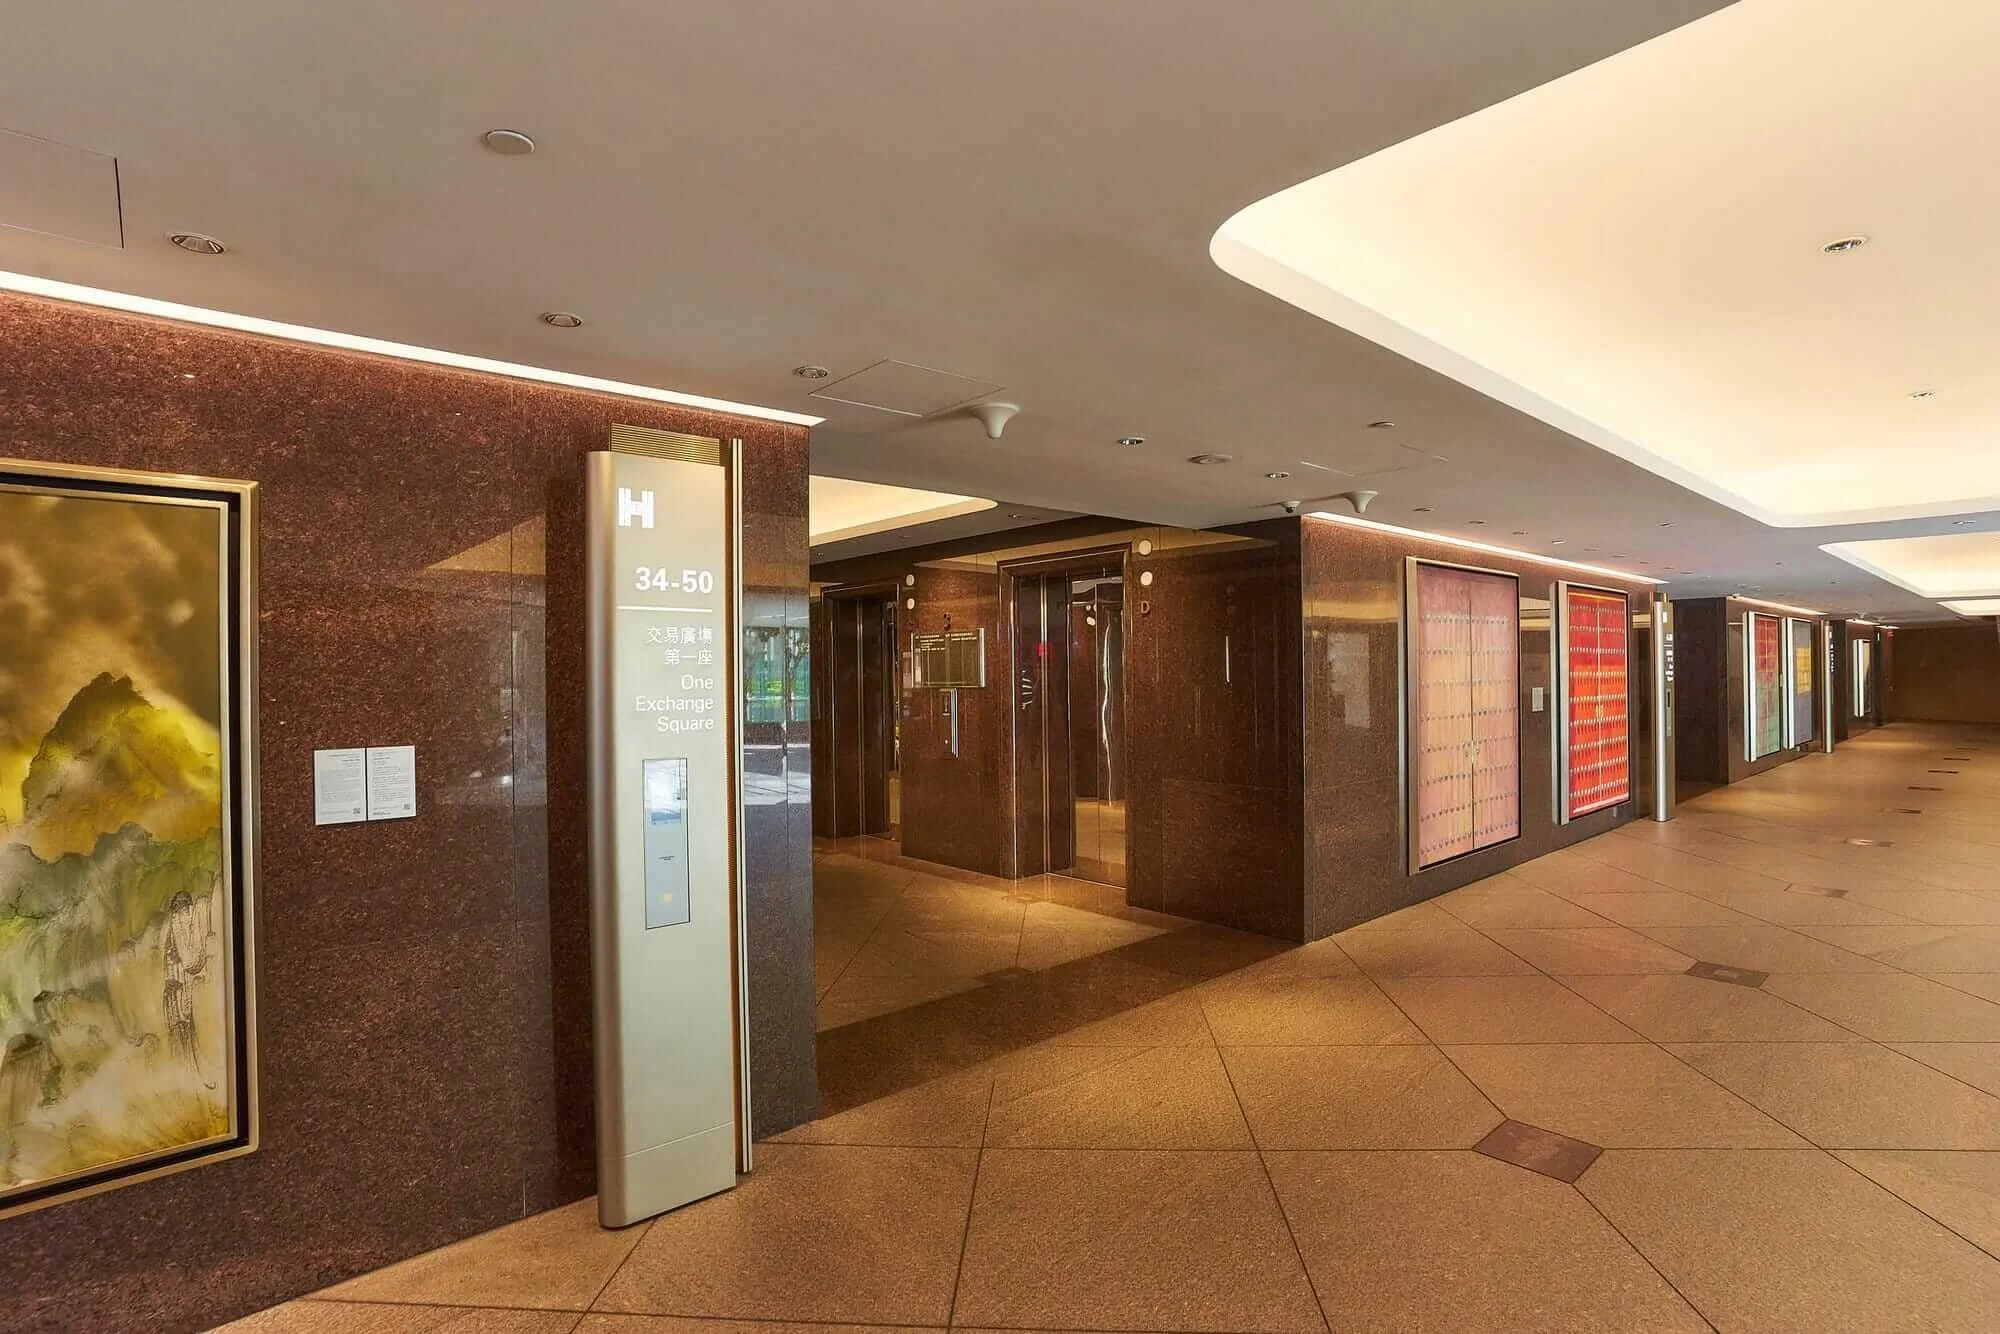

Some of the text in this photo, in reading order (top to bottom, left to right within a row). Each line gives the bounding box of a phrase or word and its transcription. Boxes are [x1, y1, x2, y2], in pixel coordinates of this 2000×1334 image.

[618, 487, 654, 529] H
[634, 566, 714, 592] 34-50
[1140, 600, 1150, 614] D
[663, 647, 713, 665] 第一座
[680, 673, 714, 690] One
[636, 695, 714, 713] Exchange
[657, 715, 714, 735] Square
